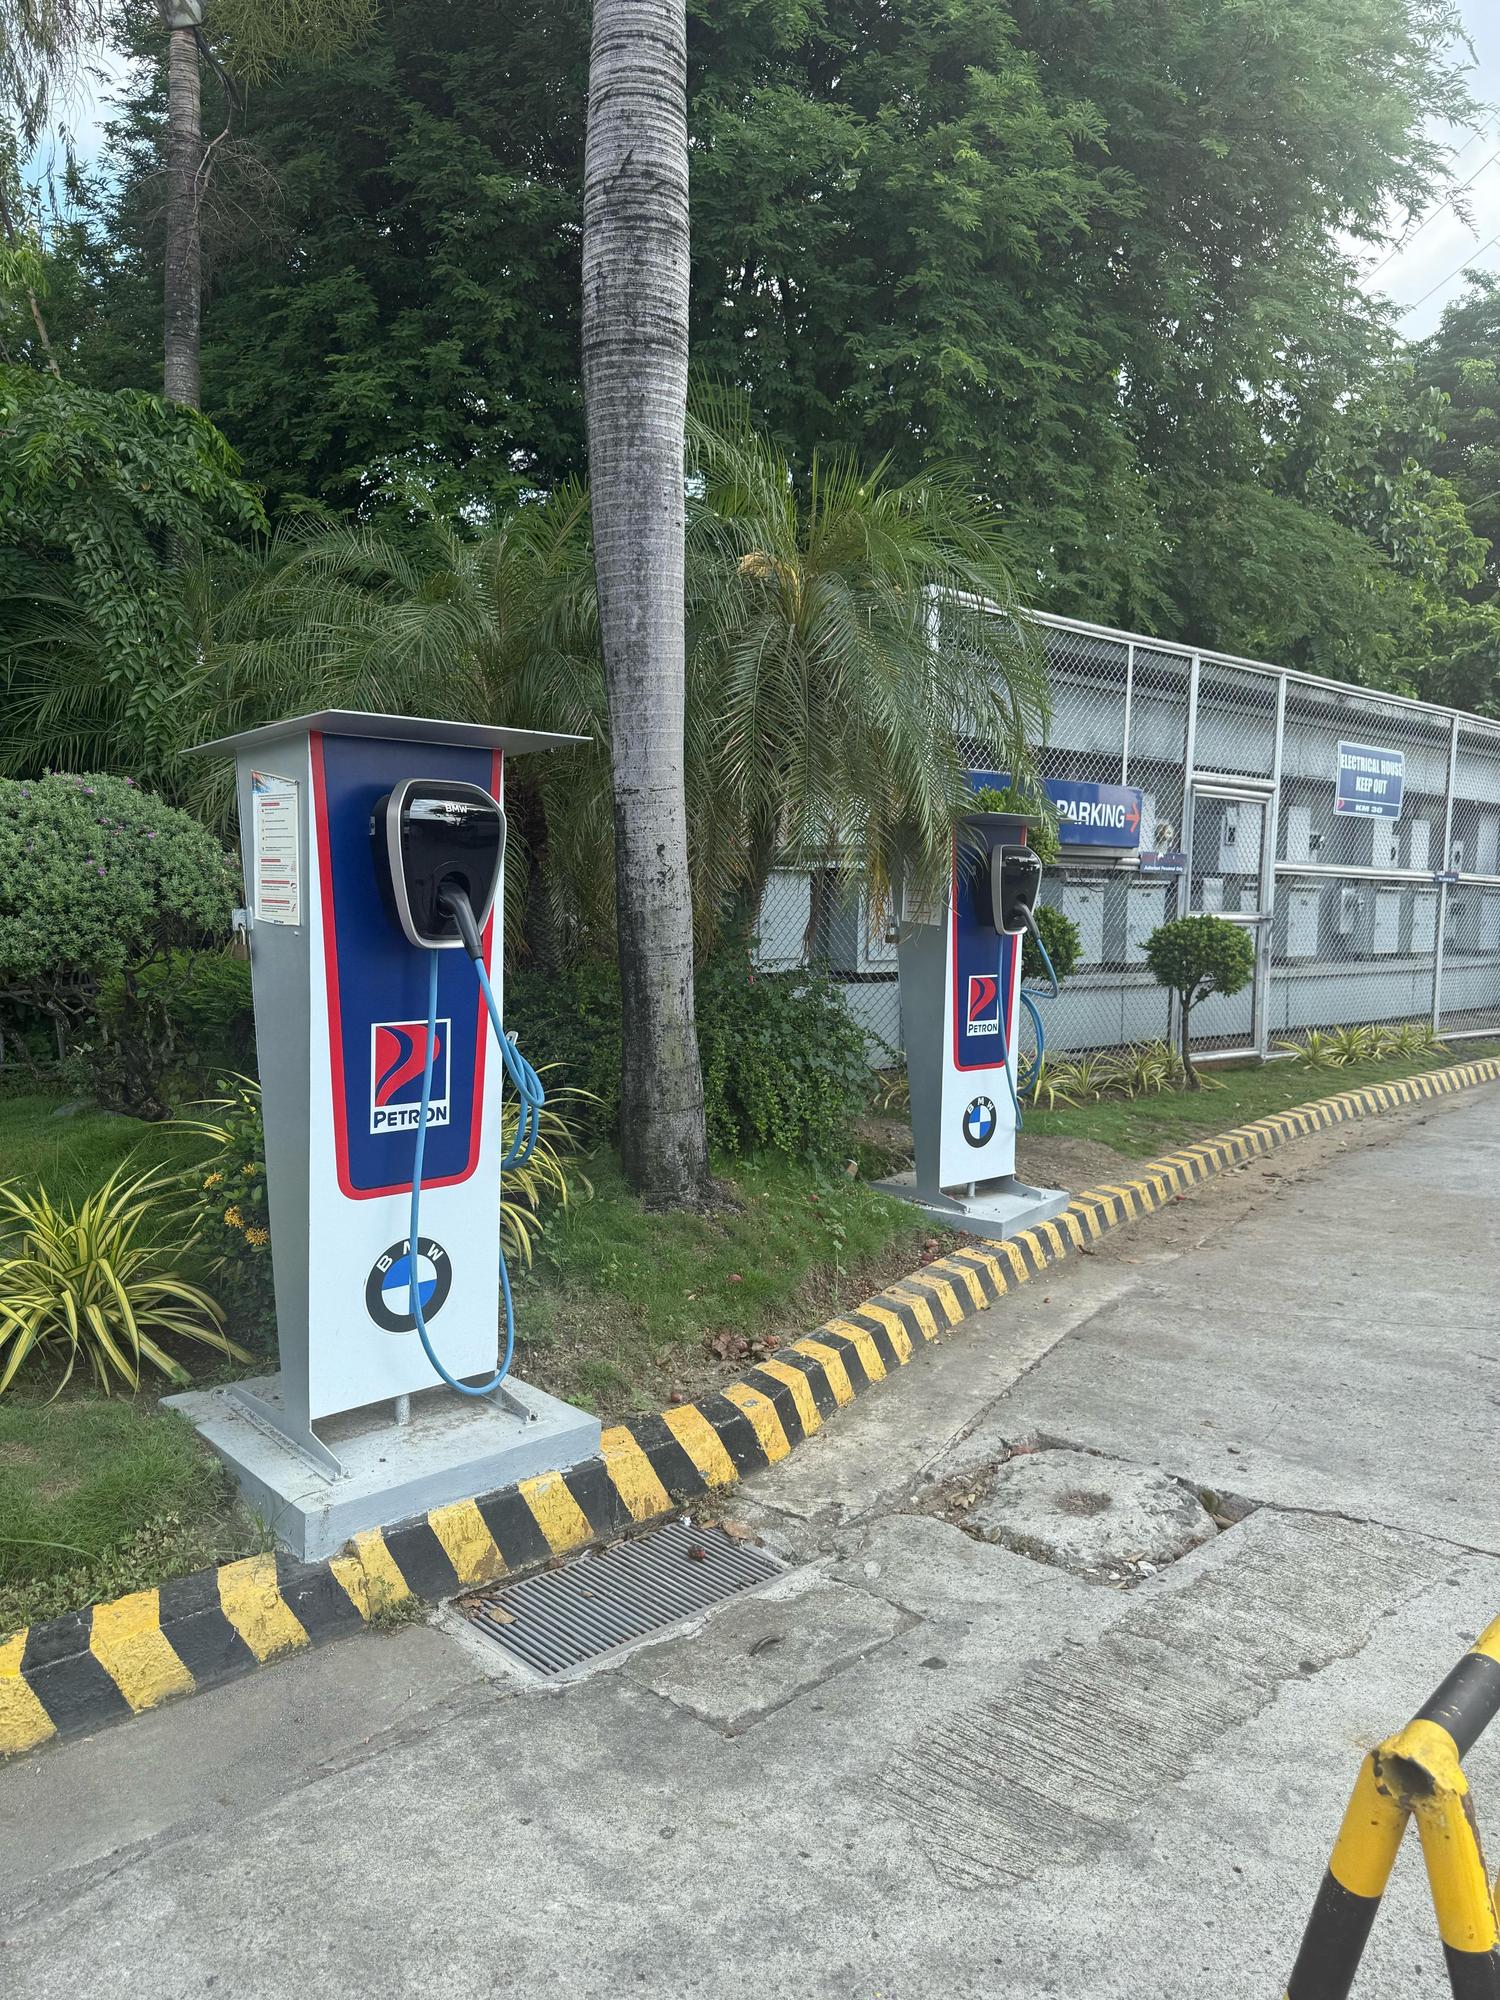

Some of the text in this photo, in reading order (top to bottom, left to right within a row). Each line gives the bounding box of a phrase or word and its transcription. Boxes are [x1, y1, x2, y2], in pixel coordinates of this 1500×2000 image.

[1340, 754, 1402, 776] ELECTRICAL HOUSE
[1355, 776, 1388, 795] KEEP OUT
[445, 804, 467, 813] BMW
[1056, 799, 1126, 829] PARKING
[1371, 805, 1383, 814] 30
[967, 1023, 997, 1034] PETRON
[966, 1097, 995, 1114] BMW
[373, 1105, 447, 1128] PETRON
